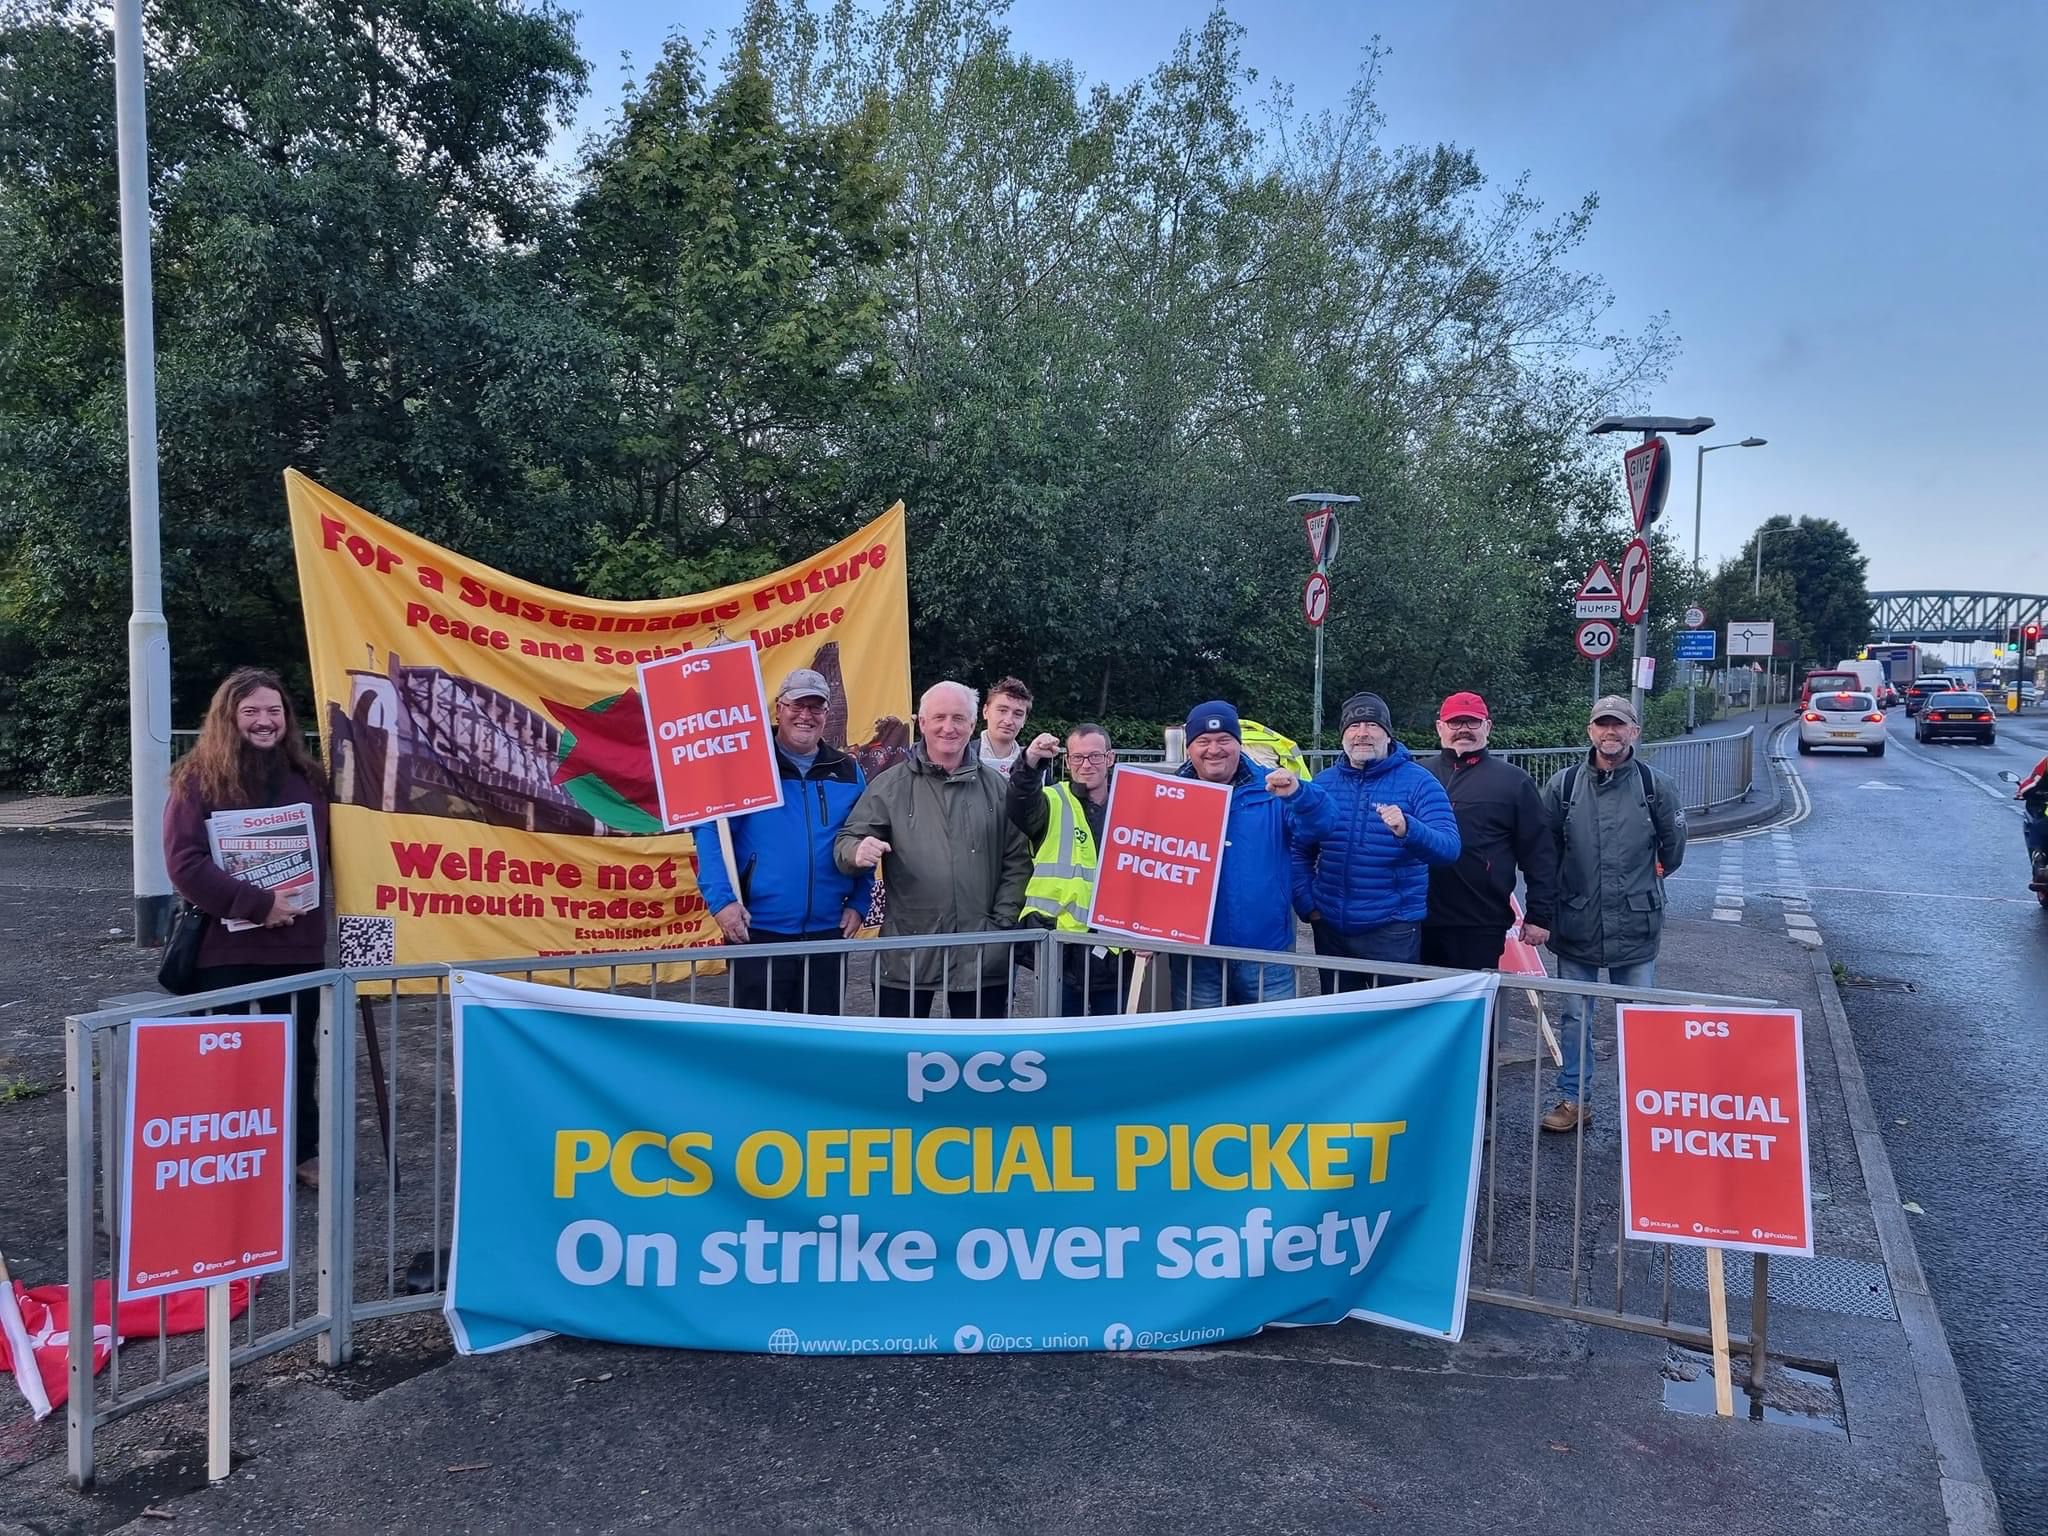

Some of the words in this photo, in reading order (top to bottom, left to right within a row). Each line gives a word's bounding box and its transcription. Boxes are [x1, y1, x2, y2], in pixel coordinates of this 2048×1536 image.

[1630, 455, 1650, 477] GIVE
[1309, 517, 1325, 531] GIVE
[320, 513, 403, 574] For
[417, 566, 444, 593] a
[752, 543, 887, 611] Future
[1580, 605, 1617, 613] HUMPS
[406, 602, 510, 650] Peace
[519, 639, 585, 662] and
[750, 606, 844, 651] Justice
[1583, 631, 1611, 646] 20
[681, 659, 711, 678] pcs
[658, 704, 757, 740] OFFICIAL
[672, 731, 751, 766] PICKET
[1155, 783, 1185, 800] pcs
[243, 808, 306, 828] Socialist
[222, 839, 250, 850] UNITE
[269, 838, 308, 849] STRIKES
[1112, 826, 1211, 862] OFFICIAL
[246, 866, 268, 881] THIS
[268, 858, 292, 873] COST
[292, 853, 304, 866] OF
[261, 860, 311, 887] NIGHTMARE
[391, 841, 583, 888] Welfare
[597, 856, 678, 890] not
[1117, 853, 1200, 886] PICKET
[376, 884, 545, 918] Plymouth
[551, 896, 665, 919] Trades
[575, 926, 661, 940] Established
[667, 920, 703, 936] 1897
[1684, 1020, 1730, 1039] pcs
[199, 1031, 242, 1055] pcs
[906, 1050, 1048, 1102] pcs
[1635, 1090, 1790, 1124] OFFICIAL
[142, 1108, 278, 1148] OFFICIAL
[1650, 1127, 1777, 1161] PICKET
[155, 1149, 267, 1191] PICKET
[553, 1129, 714, 1199] PCS
[735, 1126, 1095, 1199] OFFICIAL
[1116, 1121, 1407, 1191] PICKET
[1650, 1220, 1680, 1229] pcs.org.uk
[1703, 1226, 1740, 1235] @pcs_union
[1763, 1231, 1798, 1240] @PcsUnion
[555, 1219, 678, 1287] On
[699, 1214, 937, 1285] strike
[956, 1225, 1140, 1280] over
[1156, 1207, 1392, 1279] safety
[148, 1269, 179, 1281] pcs.org.uk
[801, 1334, 938, 1353] www.pcs.org.uk
[987, 1332, 1089, 1351] @pcs_union
[1136, 1326, 1225, 1348] @PcsUnion
